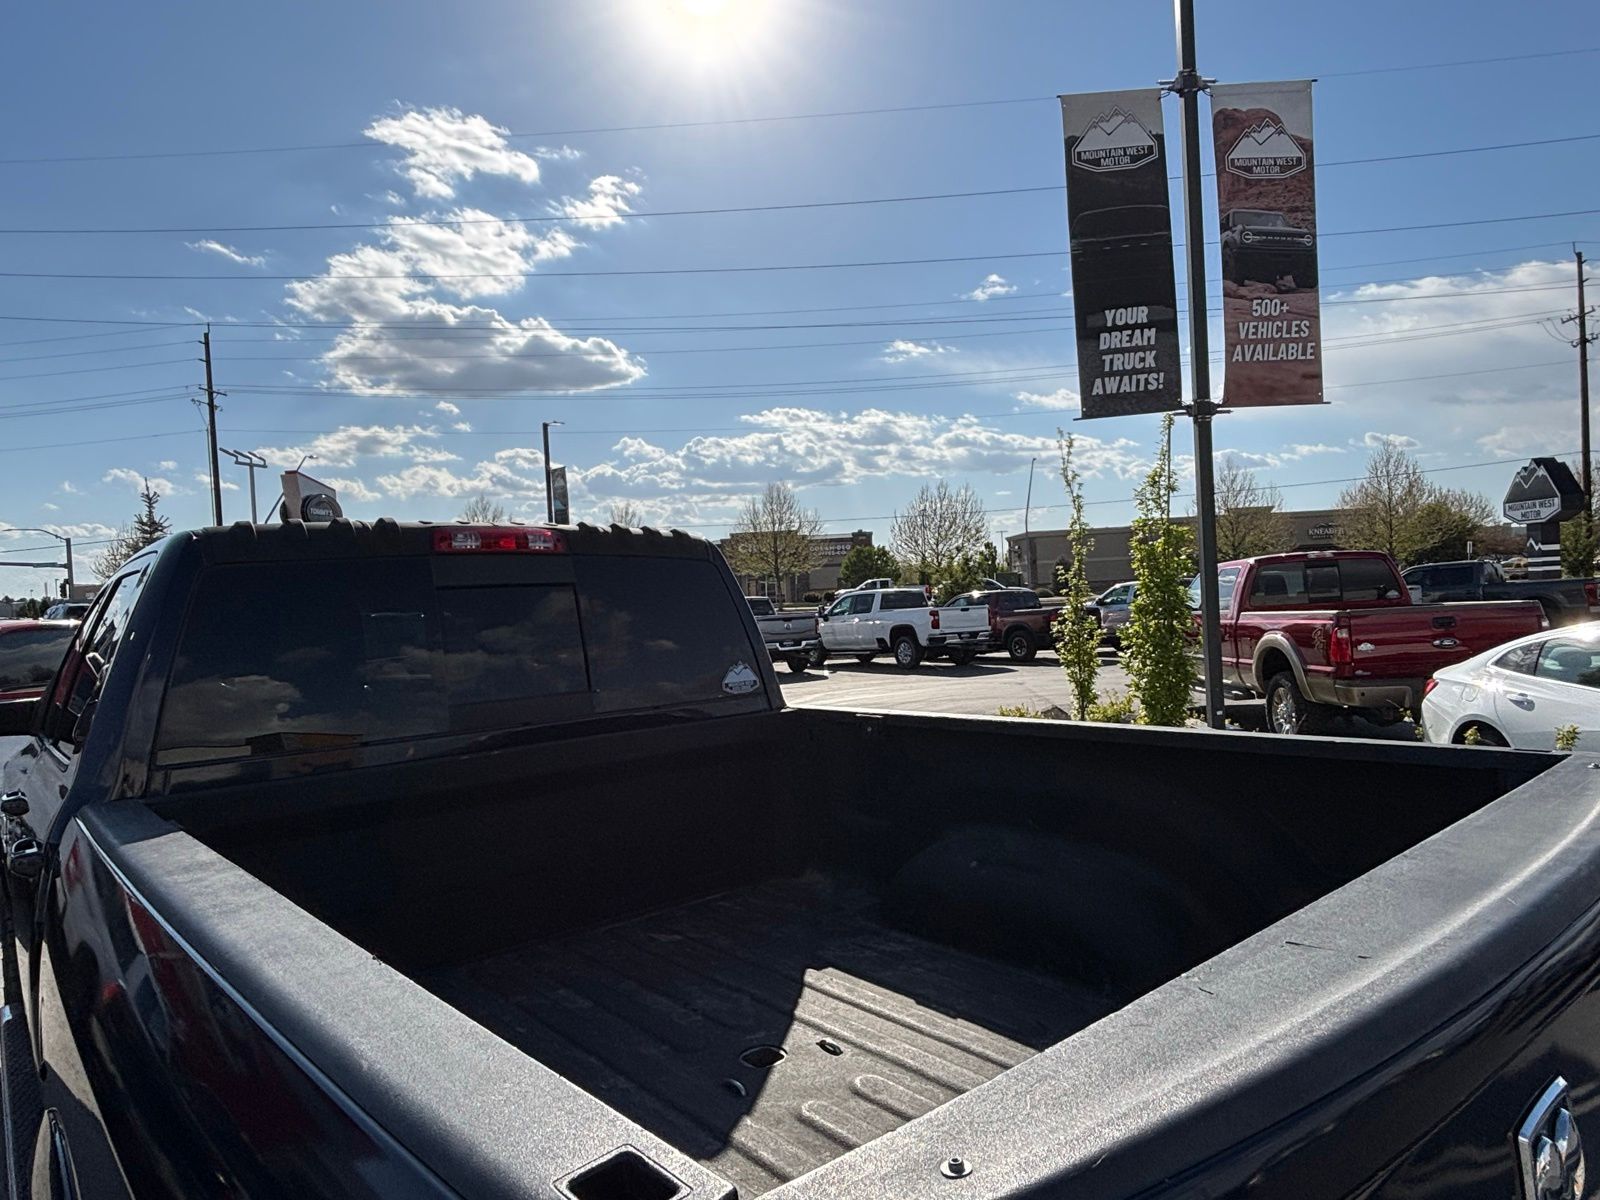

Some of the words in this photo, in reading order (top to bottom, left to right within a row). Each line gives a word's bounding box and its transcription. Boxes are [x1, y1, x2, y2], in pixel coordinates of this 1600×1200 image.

[1080, 147, 1124, 161] MOUNTAIN
[1125, 145, 1149, 156] WEST
[1100, 155, 1131, 166] MOTOR
[1234, 157, 1275, 167] MOUNTAIN
[1275, 156, 1297, 166] WEST
[1252, 165, 1281, 174] MOTOR
[1104, 306, 1149, 327] YOUR
[1251, 299, 1290, 317] 500+
[1099, 328, 1157, 350] DREAM
[1238, 320, 1310, 340] VEHICLES
[1101, 351, 1157, 372] TRUCK
[1232, 342, 1316, 363] AVAILABLE
[1091, 372, 1165, 396] AWAITS!
[1507, 501, 1538, 512] MOUNTAIN
[1538, 499, 1556, 509] WEST
[1520, 510, 1542, 519] MOTOR
